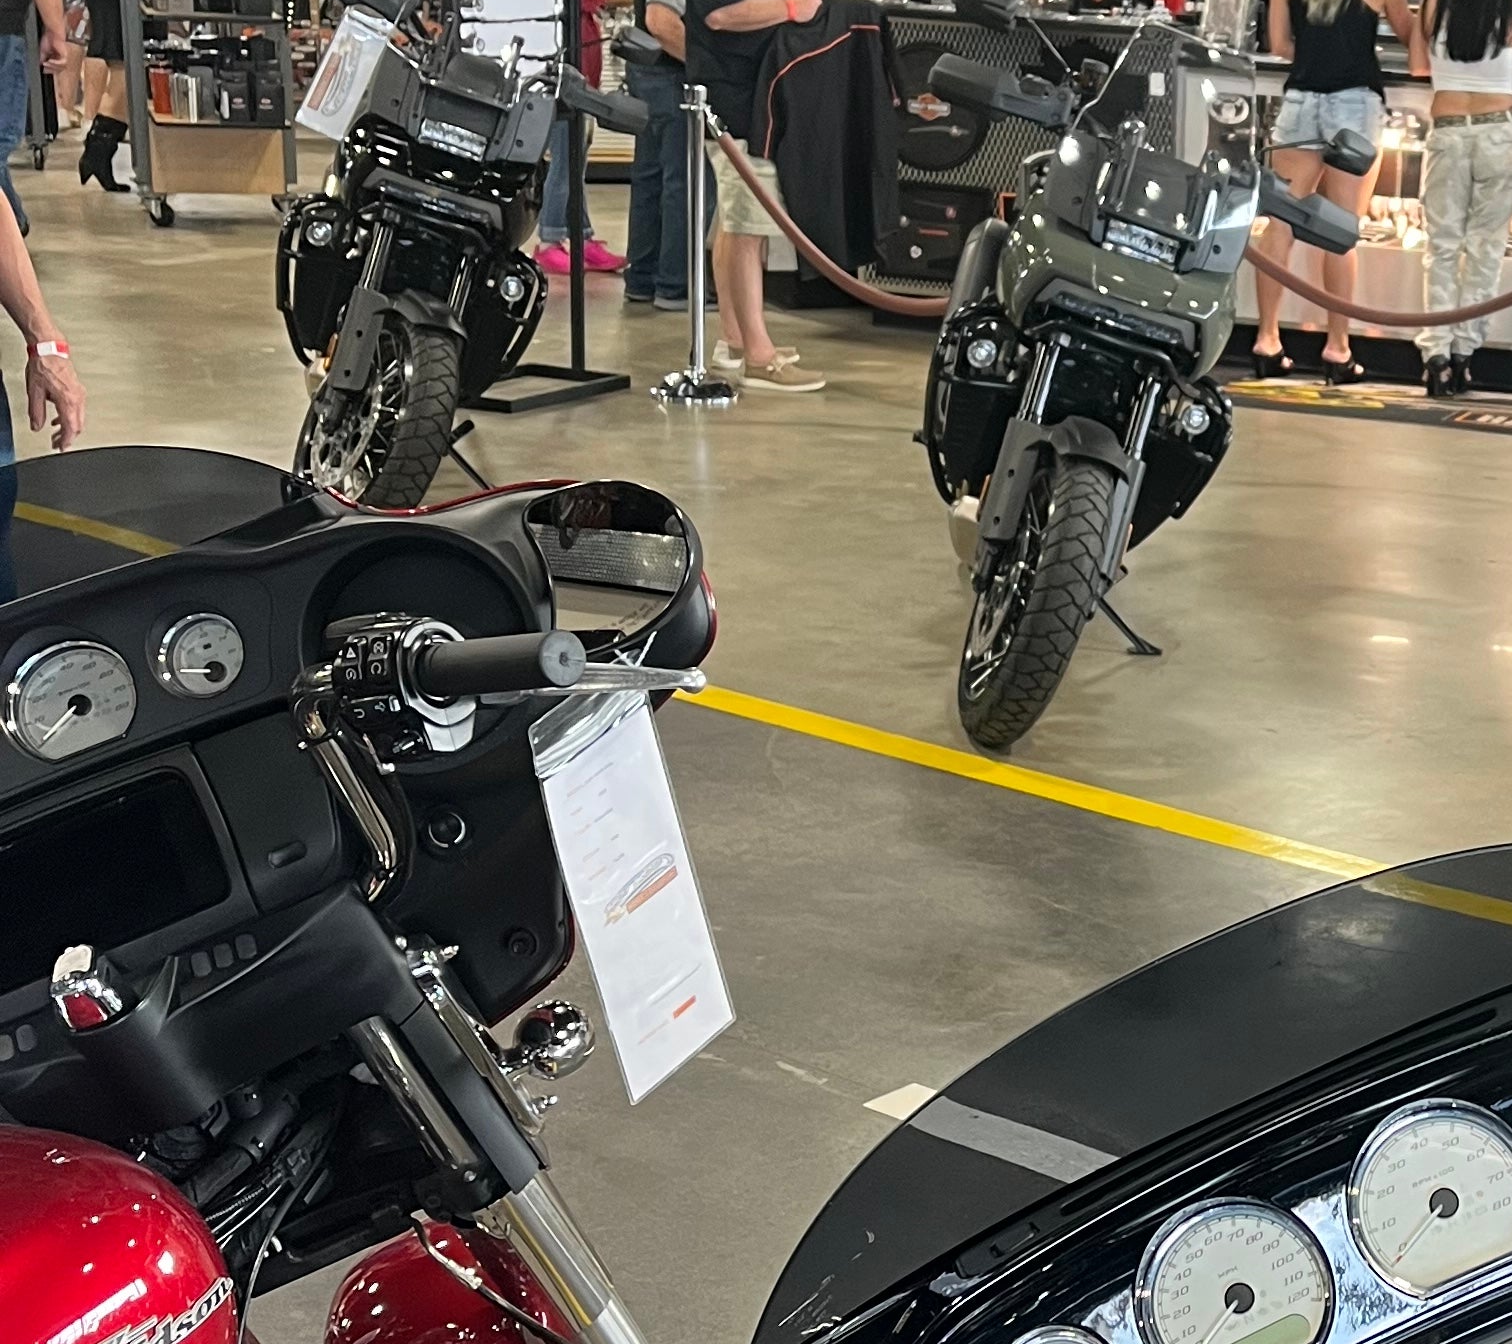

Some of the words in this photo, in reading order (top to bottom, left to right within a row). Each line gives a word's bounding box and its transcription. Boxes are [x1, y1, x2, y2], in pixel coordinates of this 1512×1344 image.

[1410, 1137, 1429, 1152] 40
[1441, 1136, 1460, 1151] 50
[1466, 1148, 1486, 1163] 60
[1386, 1159, 1407, 1174] 30
[1487, 1170, 1505, 1185] 70
[1376, 1185, 1395, 1200] 20
[1492, 1196, 1512, 1211] 80
[1381, 1217, 1397, 1231] 10
[1204, 1231, 1224, 1247] 60
[1227, 1228, 1245, 1243] 70
[1245, 1231, 1264, 1246] 80
[1262, 1239, 1281, 1256] 90
[1185, 1248, 1204, 1264] 50
[1270, 1253, 1295, 1271] 100
[1174, 1267, 1192, 1282] 40
[1218, 1265, 1239, 1279] MPH
[1284, 1270, 1304, 1287] 110
[1170, 1285, 1190, 1301] 30
[1287, 1287, 1310, 1305] 120
[1172, 1304, 1192, 1321] 20
[1181, 1324, 1197, 1339] 10
